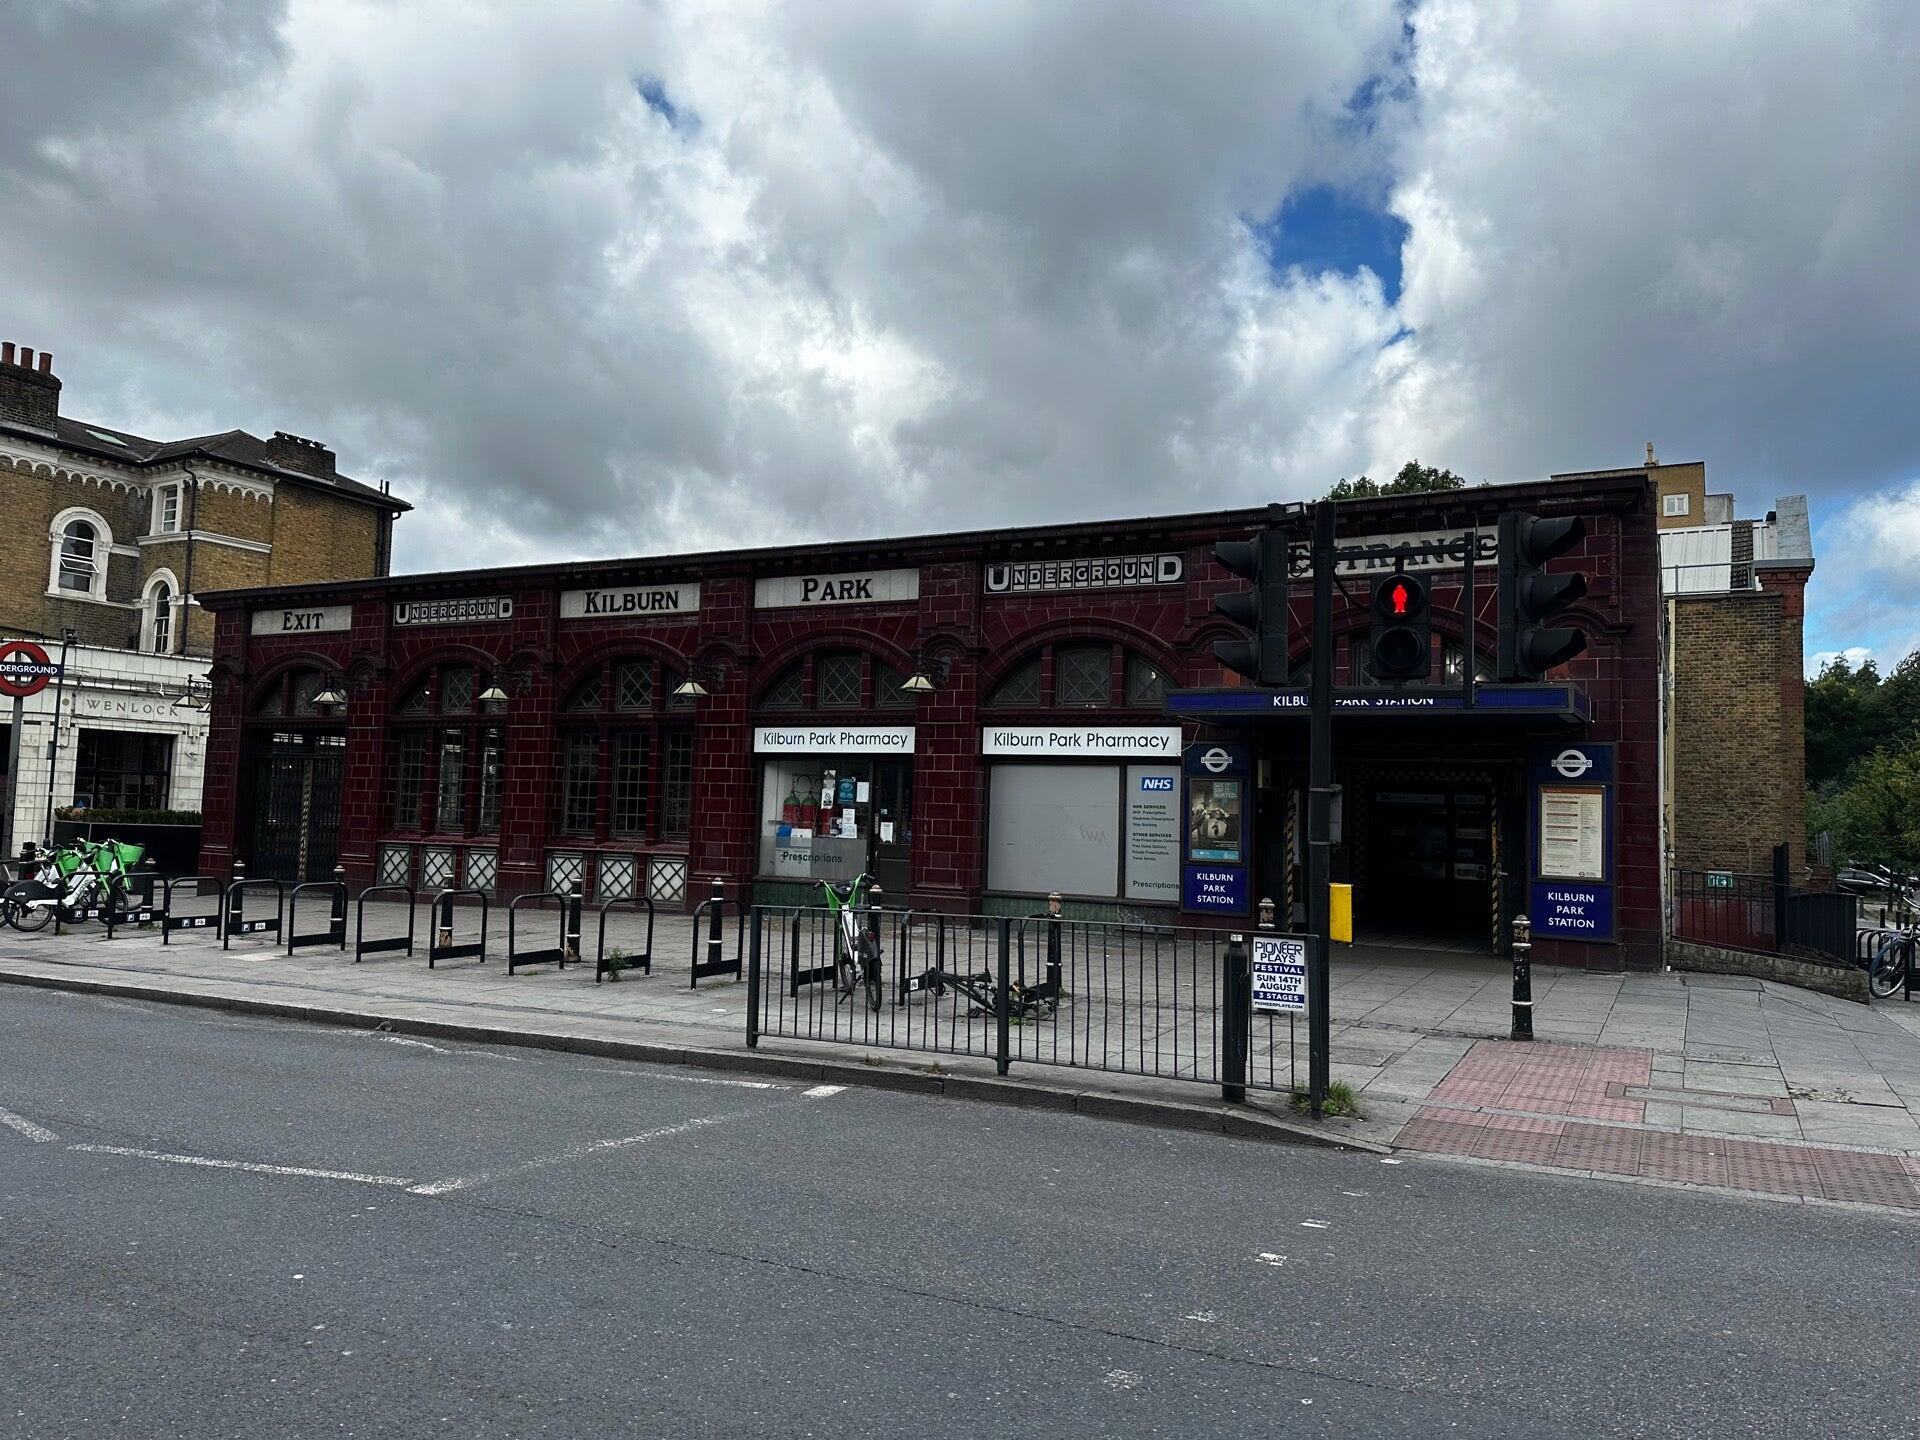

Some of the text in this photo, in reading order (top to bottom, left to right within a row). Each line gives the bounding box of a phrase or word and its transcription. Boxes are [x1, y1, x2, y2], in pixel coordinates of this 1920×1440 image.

[1288, 533, 1498, 574] ETRANCE
[988, 555, 1183, 591] UNDERGROUND
[801, 578, 873, 602] PARK
[584, 590, 679, 614] KILBURN
[396, 599, 513, 624] UNDERGROUND
[282, 611, 324, 631] EXIT
[0, 664, 58, 675] DERGROUND
[1273, 696, 1308, 706] KILBU
[86, 699, 179, 716] WENLOCK
[763, 732, 909, 748] Kilburn Park Pharmacy
[994, 732, 1170, 750] Kilburn Park Pharmacy
[1143, 778, 1172, 789] NHS
[783, 851, 842, 863] Prescripions
[1197, 872, 1233, 881] KILBURN
[1132, 880, 1180, 889] Prescriptions
[1203, 885, 1226, 893] PARK
[1197, 895, 1234, 904] STATION
[1547, 892, 1594, 903] KILBURN
[1556, 905, 1584, 915] PARK
[1548, 917, 1594, 928] STATION
[1255, 941, 1303, 956] PIONEER
[1260, 953, 1296, 963] PLAYS
[1255, 964, 1302, 974] FESTIVAL
[1256, 974, 1301, 984] SUN 14TH
[1260, 982, 1298, 992] AUGUST
[1266, 993, 1299, 1001] STAGES
[1255, 1001, 1304, 1009] PIONEERPLAYS.COM
